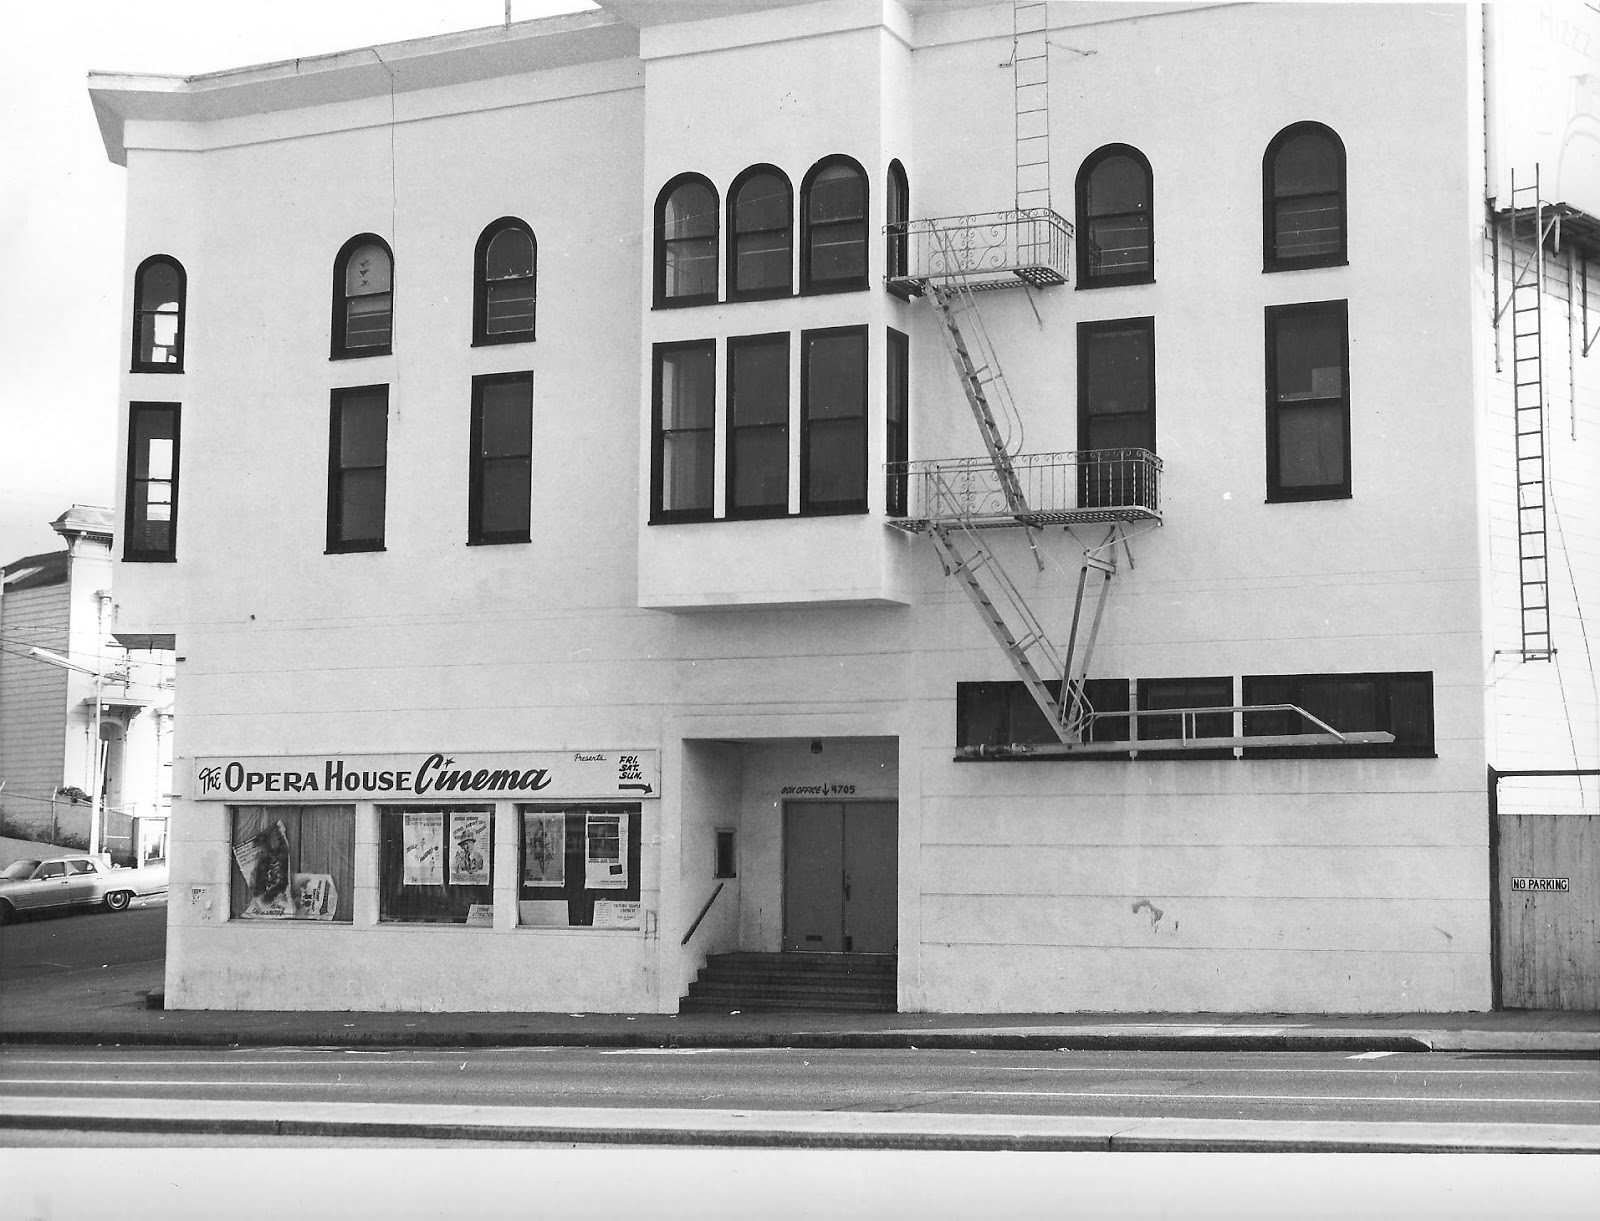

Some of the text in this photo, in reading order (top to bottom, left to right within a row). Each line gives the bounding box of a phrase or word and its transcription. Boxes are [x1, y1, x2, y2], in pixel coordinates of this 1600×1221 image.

[574, 752, 607, 762] Presents
[618, 755, 638, 764] FRI.
[618, 764, 640, 772] SAT.
[225, 761, 319, 793] OPERA
[324, 760, 412, 792] HOUSE
[414, 753, 552, 795] Cinema
[618, 772, 642, 780] SUN.
[781, 785, 856, 795] BOX OFFICE 4705
[1513, 879, 1568, 890] NO PARKING
